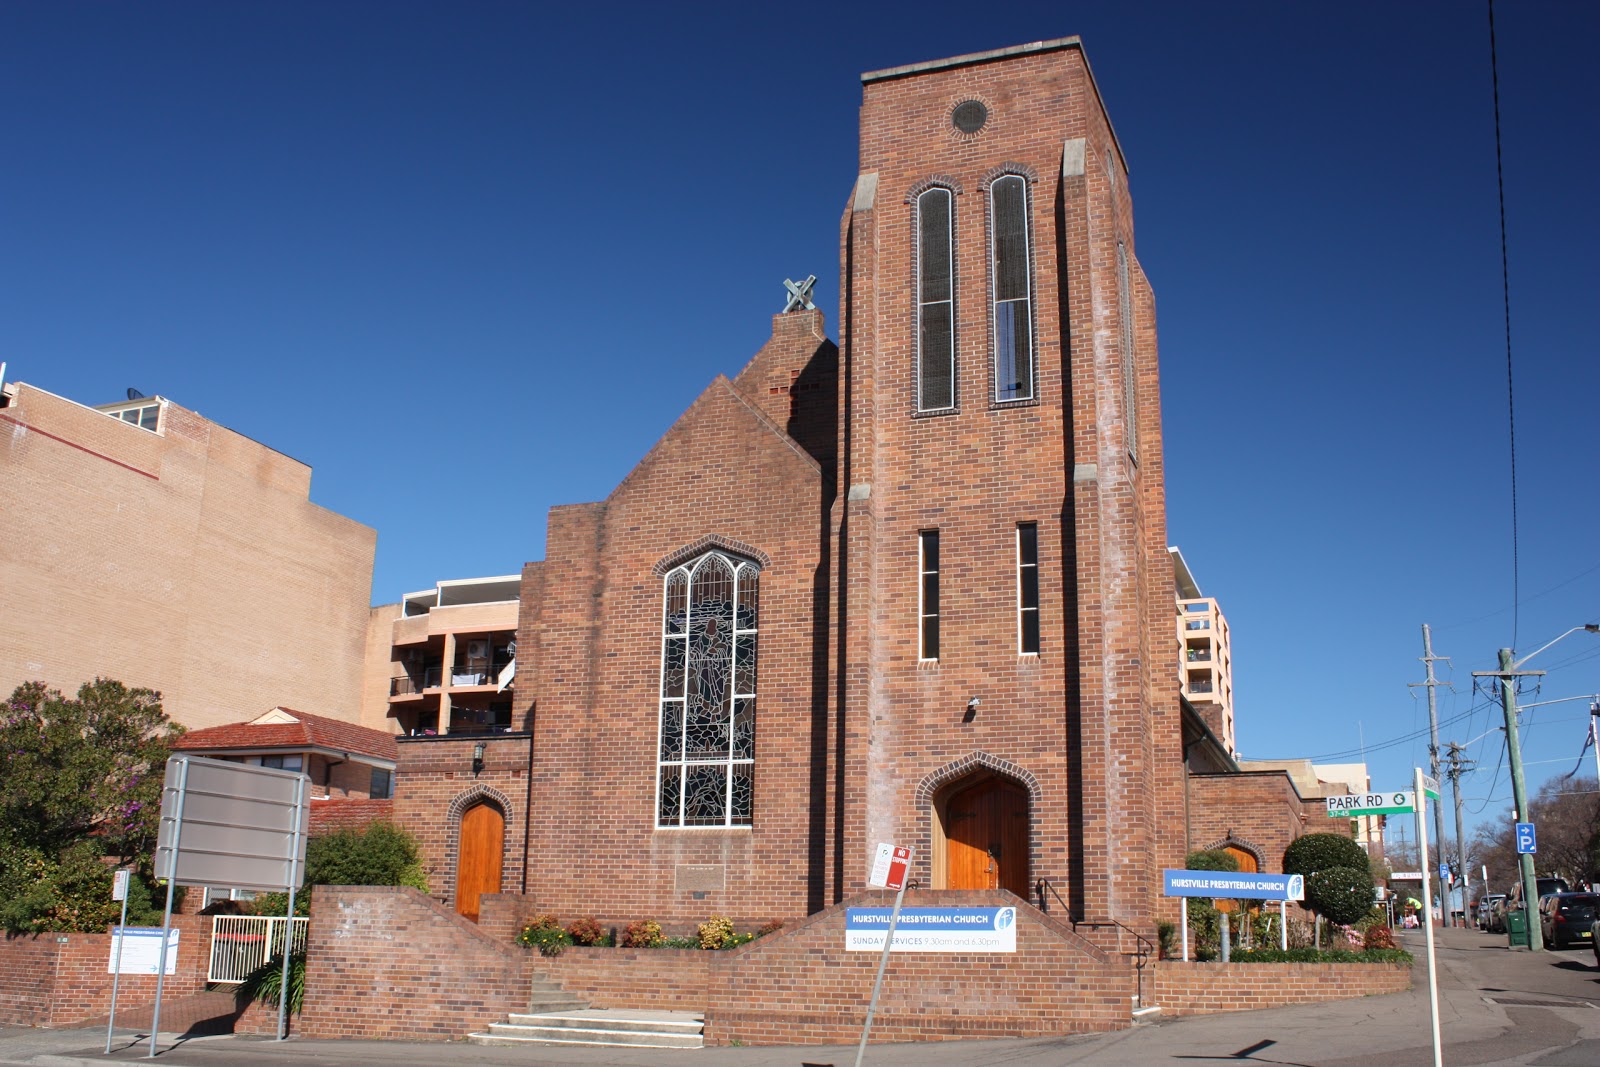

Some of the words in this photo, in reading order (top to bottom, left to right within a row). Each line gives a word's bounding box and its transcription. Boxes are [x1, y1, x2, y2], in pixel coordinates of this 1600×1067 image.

[1328, 796, 1362, 809] PARK
[1366, 795, 1383, 807] RD
[1520, 835, 1532, 850] P
[897, 849, 906, 857] NO
[1171, 878, 1209, 888] HURSTVILLE
[1210, 880, 1256, 890] PRESBYTERIAN
[1256, 881, 1285, 891] CHURCH
[852, 915, 893, 923] HURSTVILL
[897, 915, 952, 923] PRESBYTERIAN
[953, 915, 989, 923] CHURCH
[852, 937, 885, 945] SUNDAY
[890, 937, 923, 945] ERVICES
[924, 937, 953, 946] 9.30am
[953, 938, 970, 946] and
[971, 938, 1000, 947] 6.30pm
